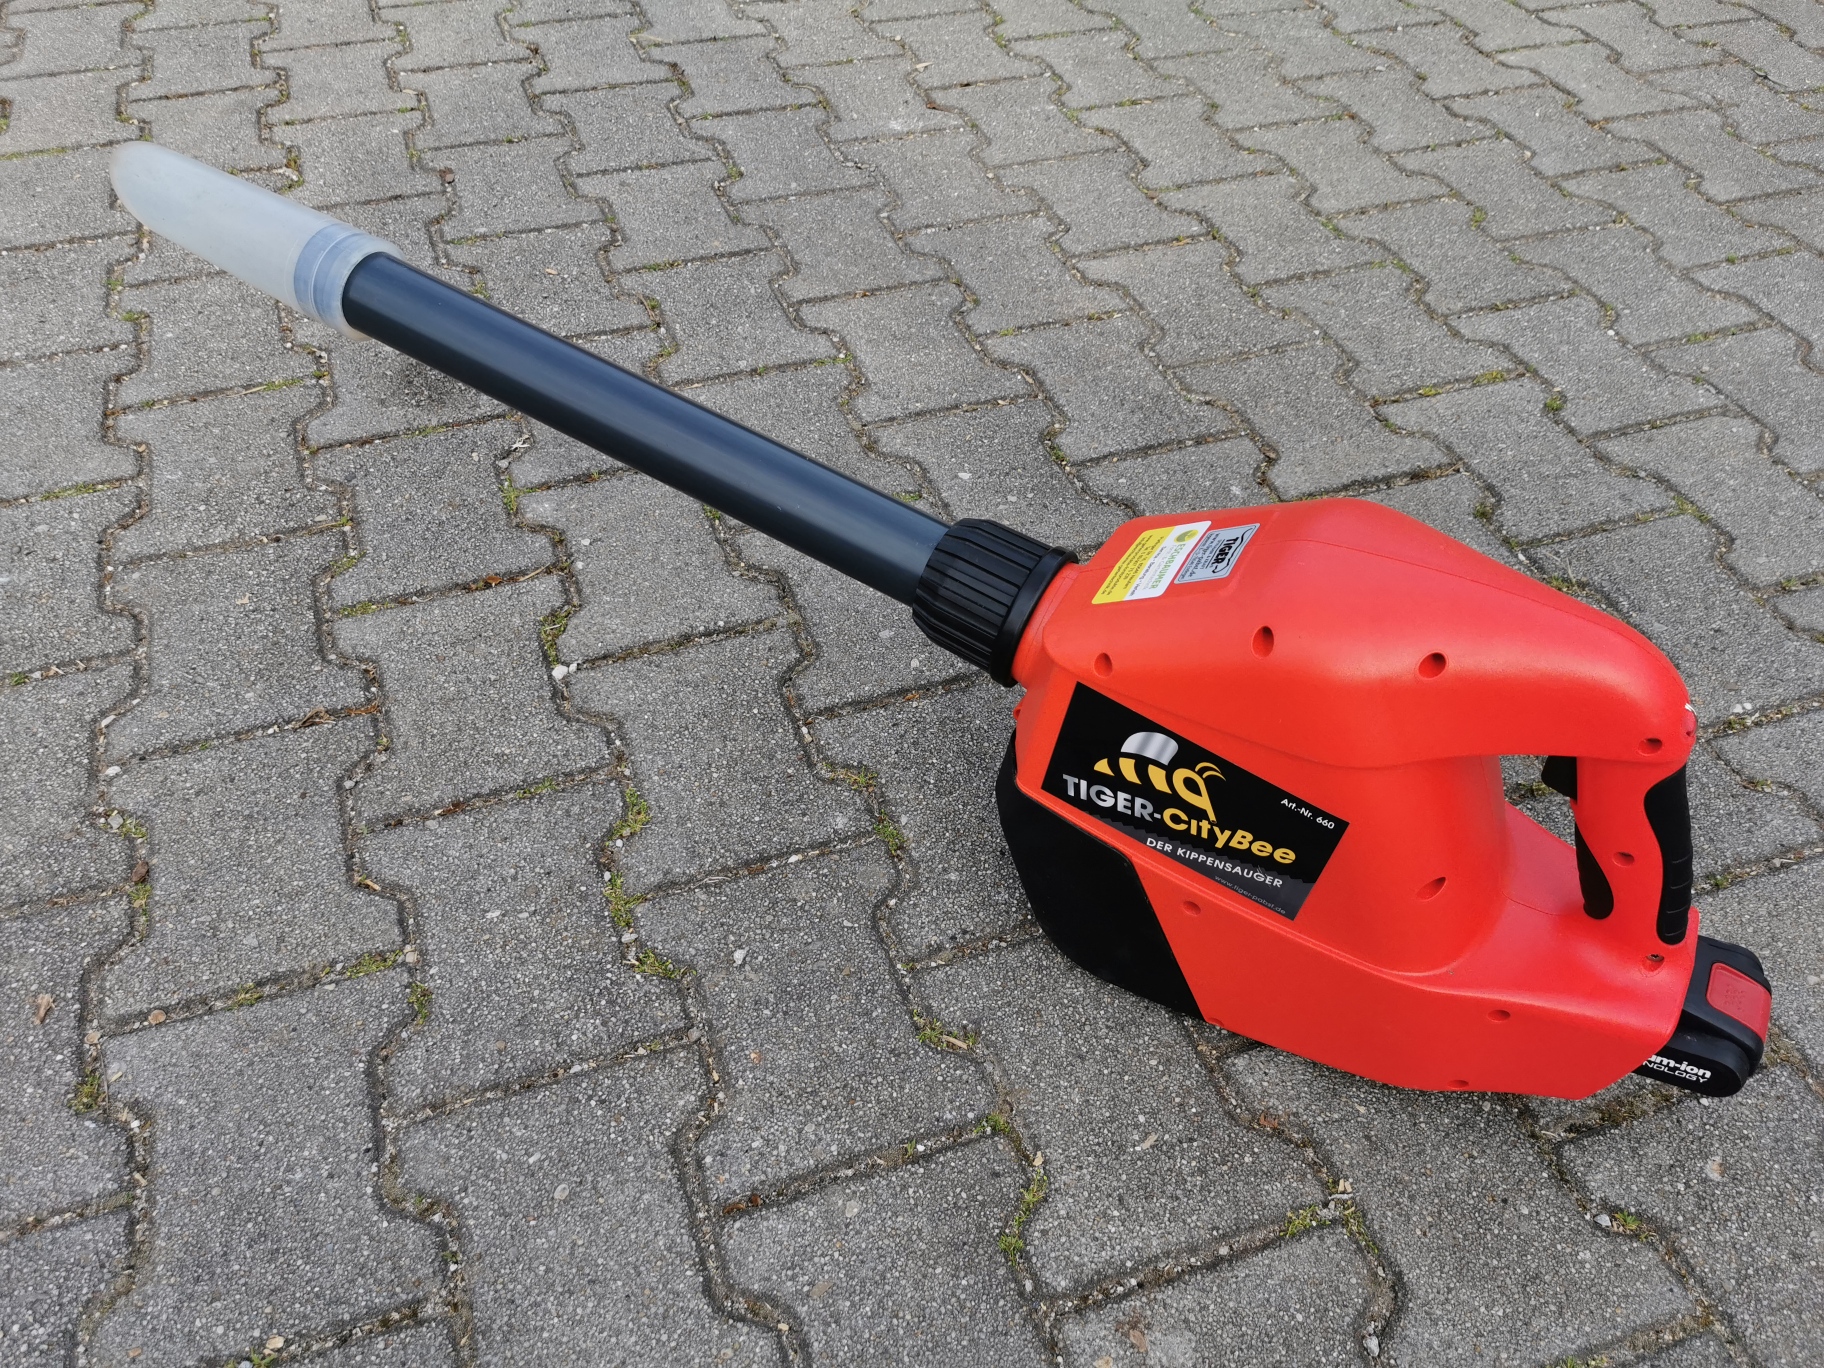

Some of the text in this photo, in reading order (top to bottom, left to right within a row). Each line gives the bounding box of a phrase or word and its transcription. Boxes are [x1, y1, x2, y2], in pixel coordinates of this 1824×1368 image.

[1151, 543, 1186, 588] ESCHBAUMER
[1211, 537, 1240, 565] TIGER
[1280, 798, 1336, 830] Art.-Nr. 660
[1146, 837, 1284, 888] DER KIPPENSAUGER
[1214, 875, 1287, 915] www.tiger-pabst.de
